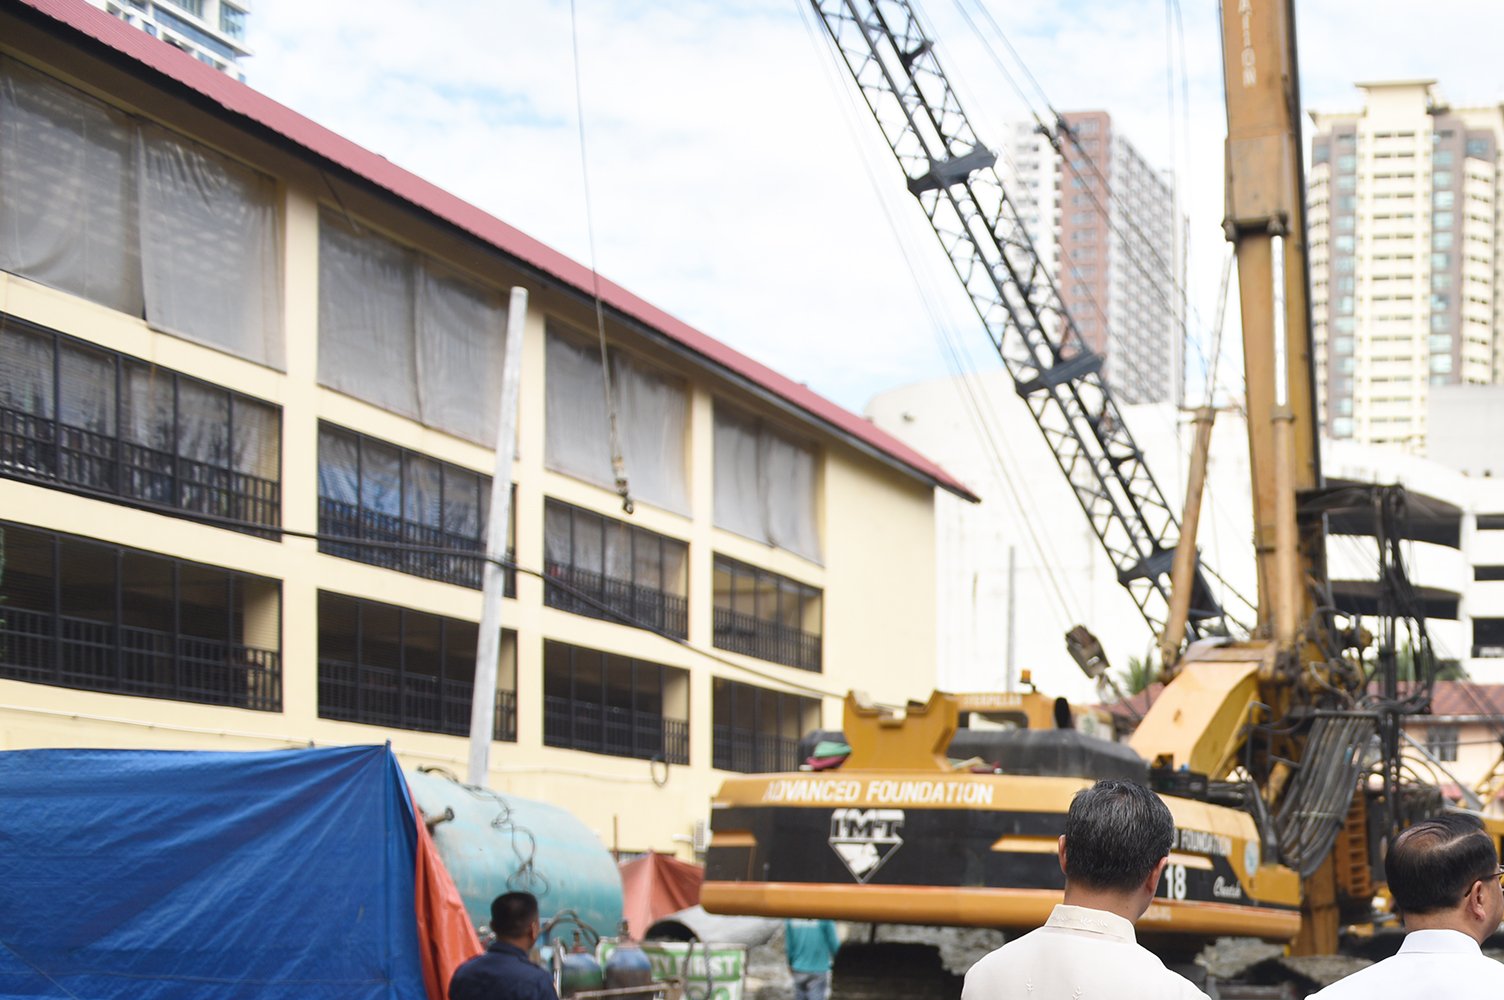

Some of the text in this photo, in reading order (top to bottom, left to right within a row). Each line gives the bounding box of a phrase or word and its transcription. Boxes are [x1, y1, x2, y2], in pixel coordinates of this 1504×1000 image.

[762, 780, 993, 804] ADVANCED FOUNDATION
[831, 809, 905, 838] IMT
[1164, 864, 1187, 900] 18
